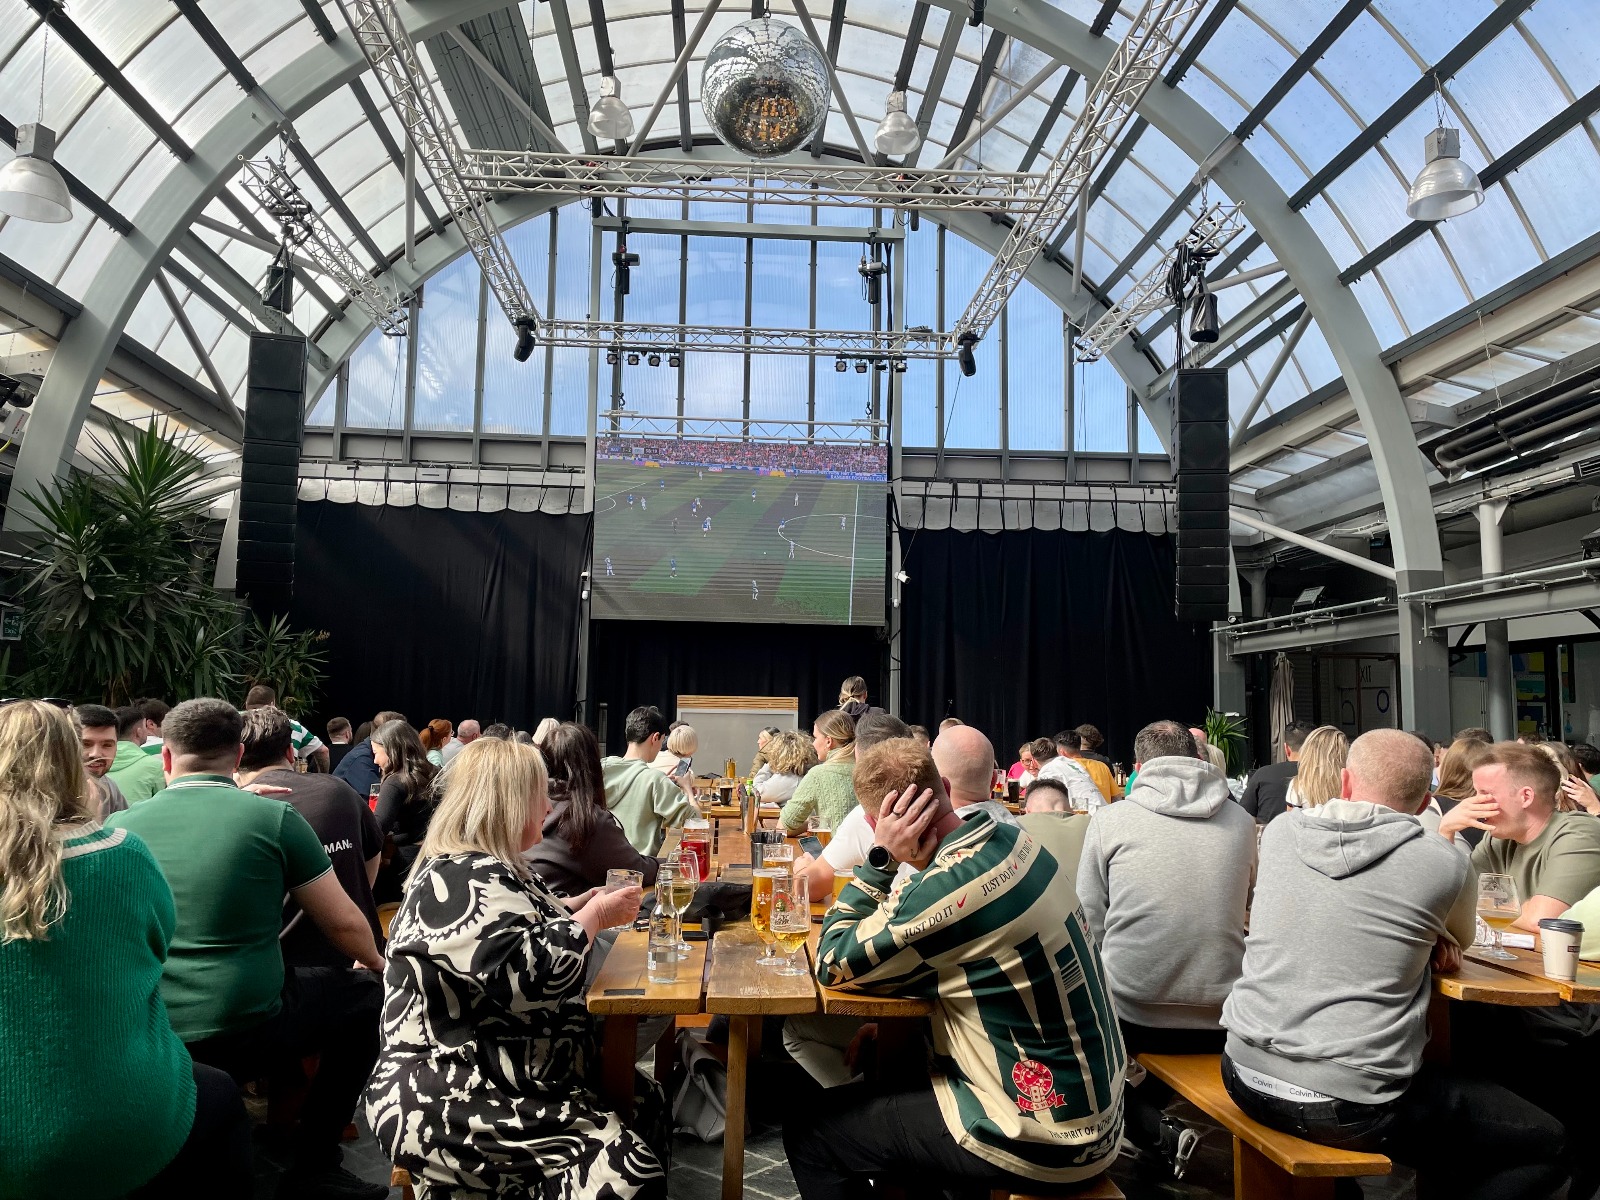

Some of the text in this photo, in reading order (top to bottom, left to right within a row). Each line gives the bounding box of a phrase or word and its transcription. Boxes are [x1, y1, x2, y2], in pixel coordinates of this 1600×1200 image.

[980, 866, 1016, 896] JUST DO IT
[903, 904, 954, 939] JUST DO IT
[1252, 1076, 1273, 1089] Calvin
[1289, 1087, 1312, 1098] Calvin
[1060, 1127, 1082, 1139] SPIRIT
[1084, 1126, 1095, 1136] OF
